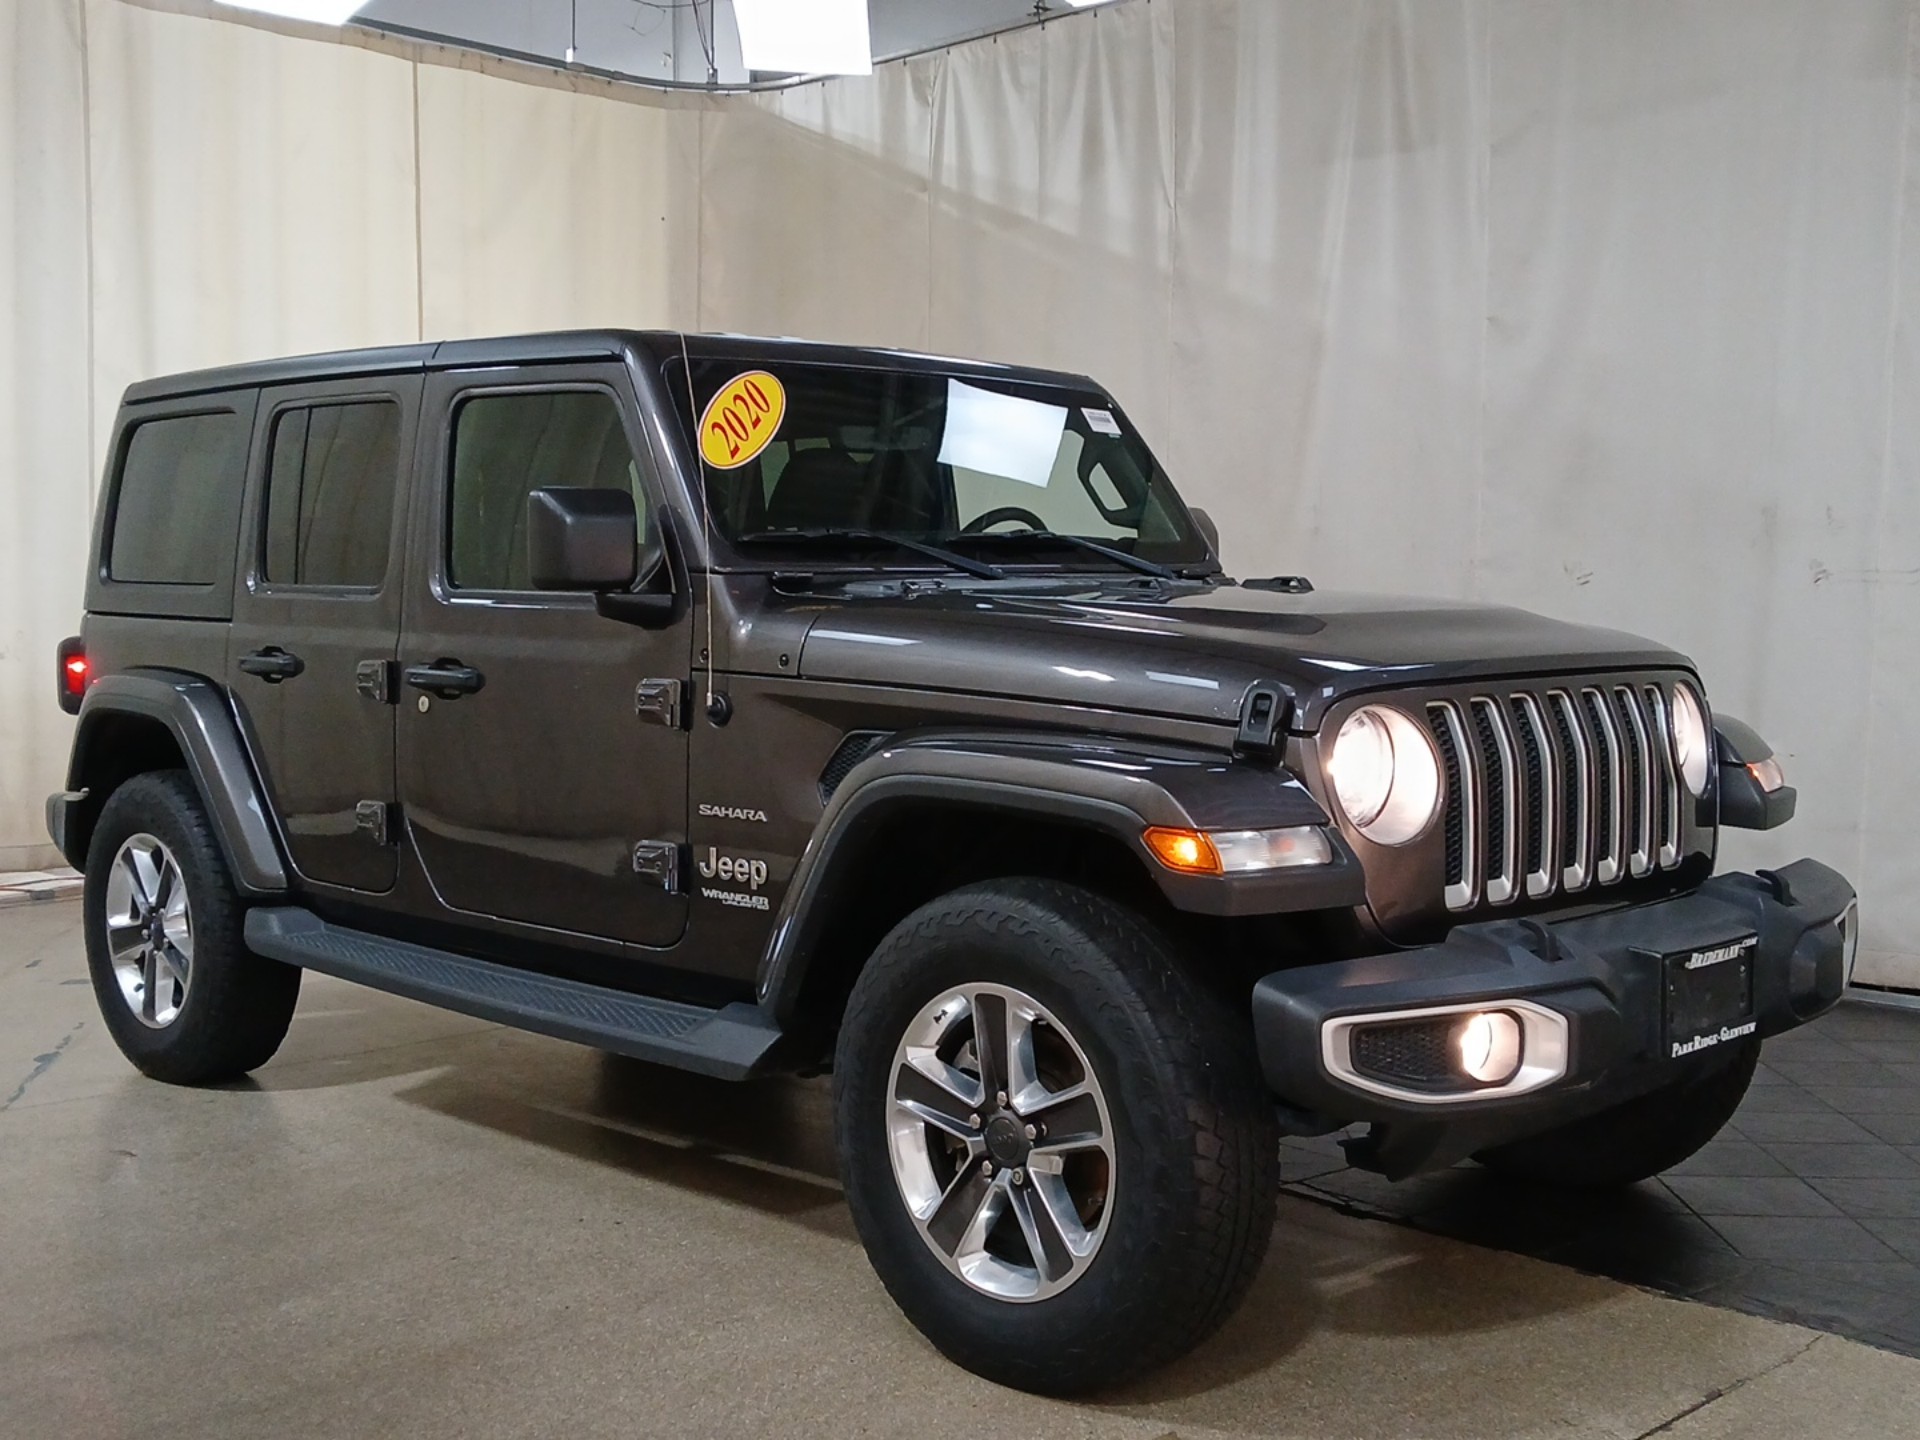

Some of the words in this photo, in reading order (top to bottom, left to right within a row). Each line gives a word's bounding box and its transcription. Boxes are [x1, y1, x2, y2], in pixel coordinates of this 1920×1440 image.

[711, 379, 770, 460] 2020
[699, 804, 767, 822] SAHARA
[699, 847, 767, 890] Jeep
[701, 887, 768, 905] WRANGLER
